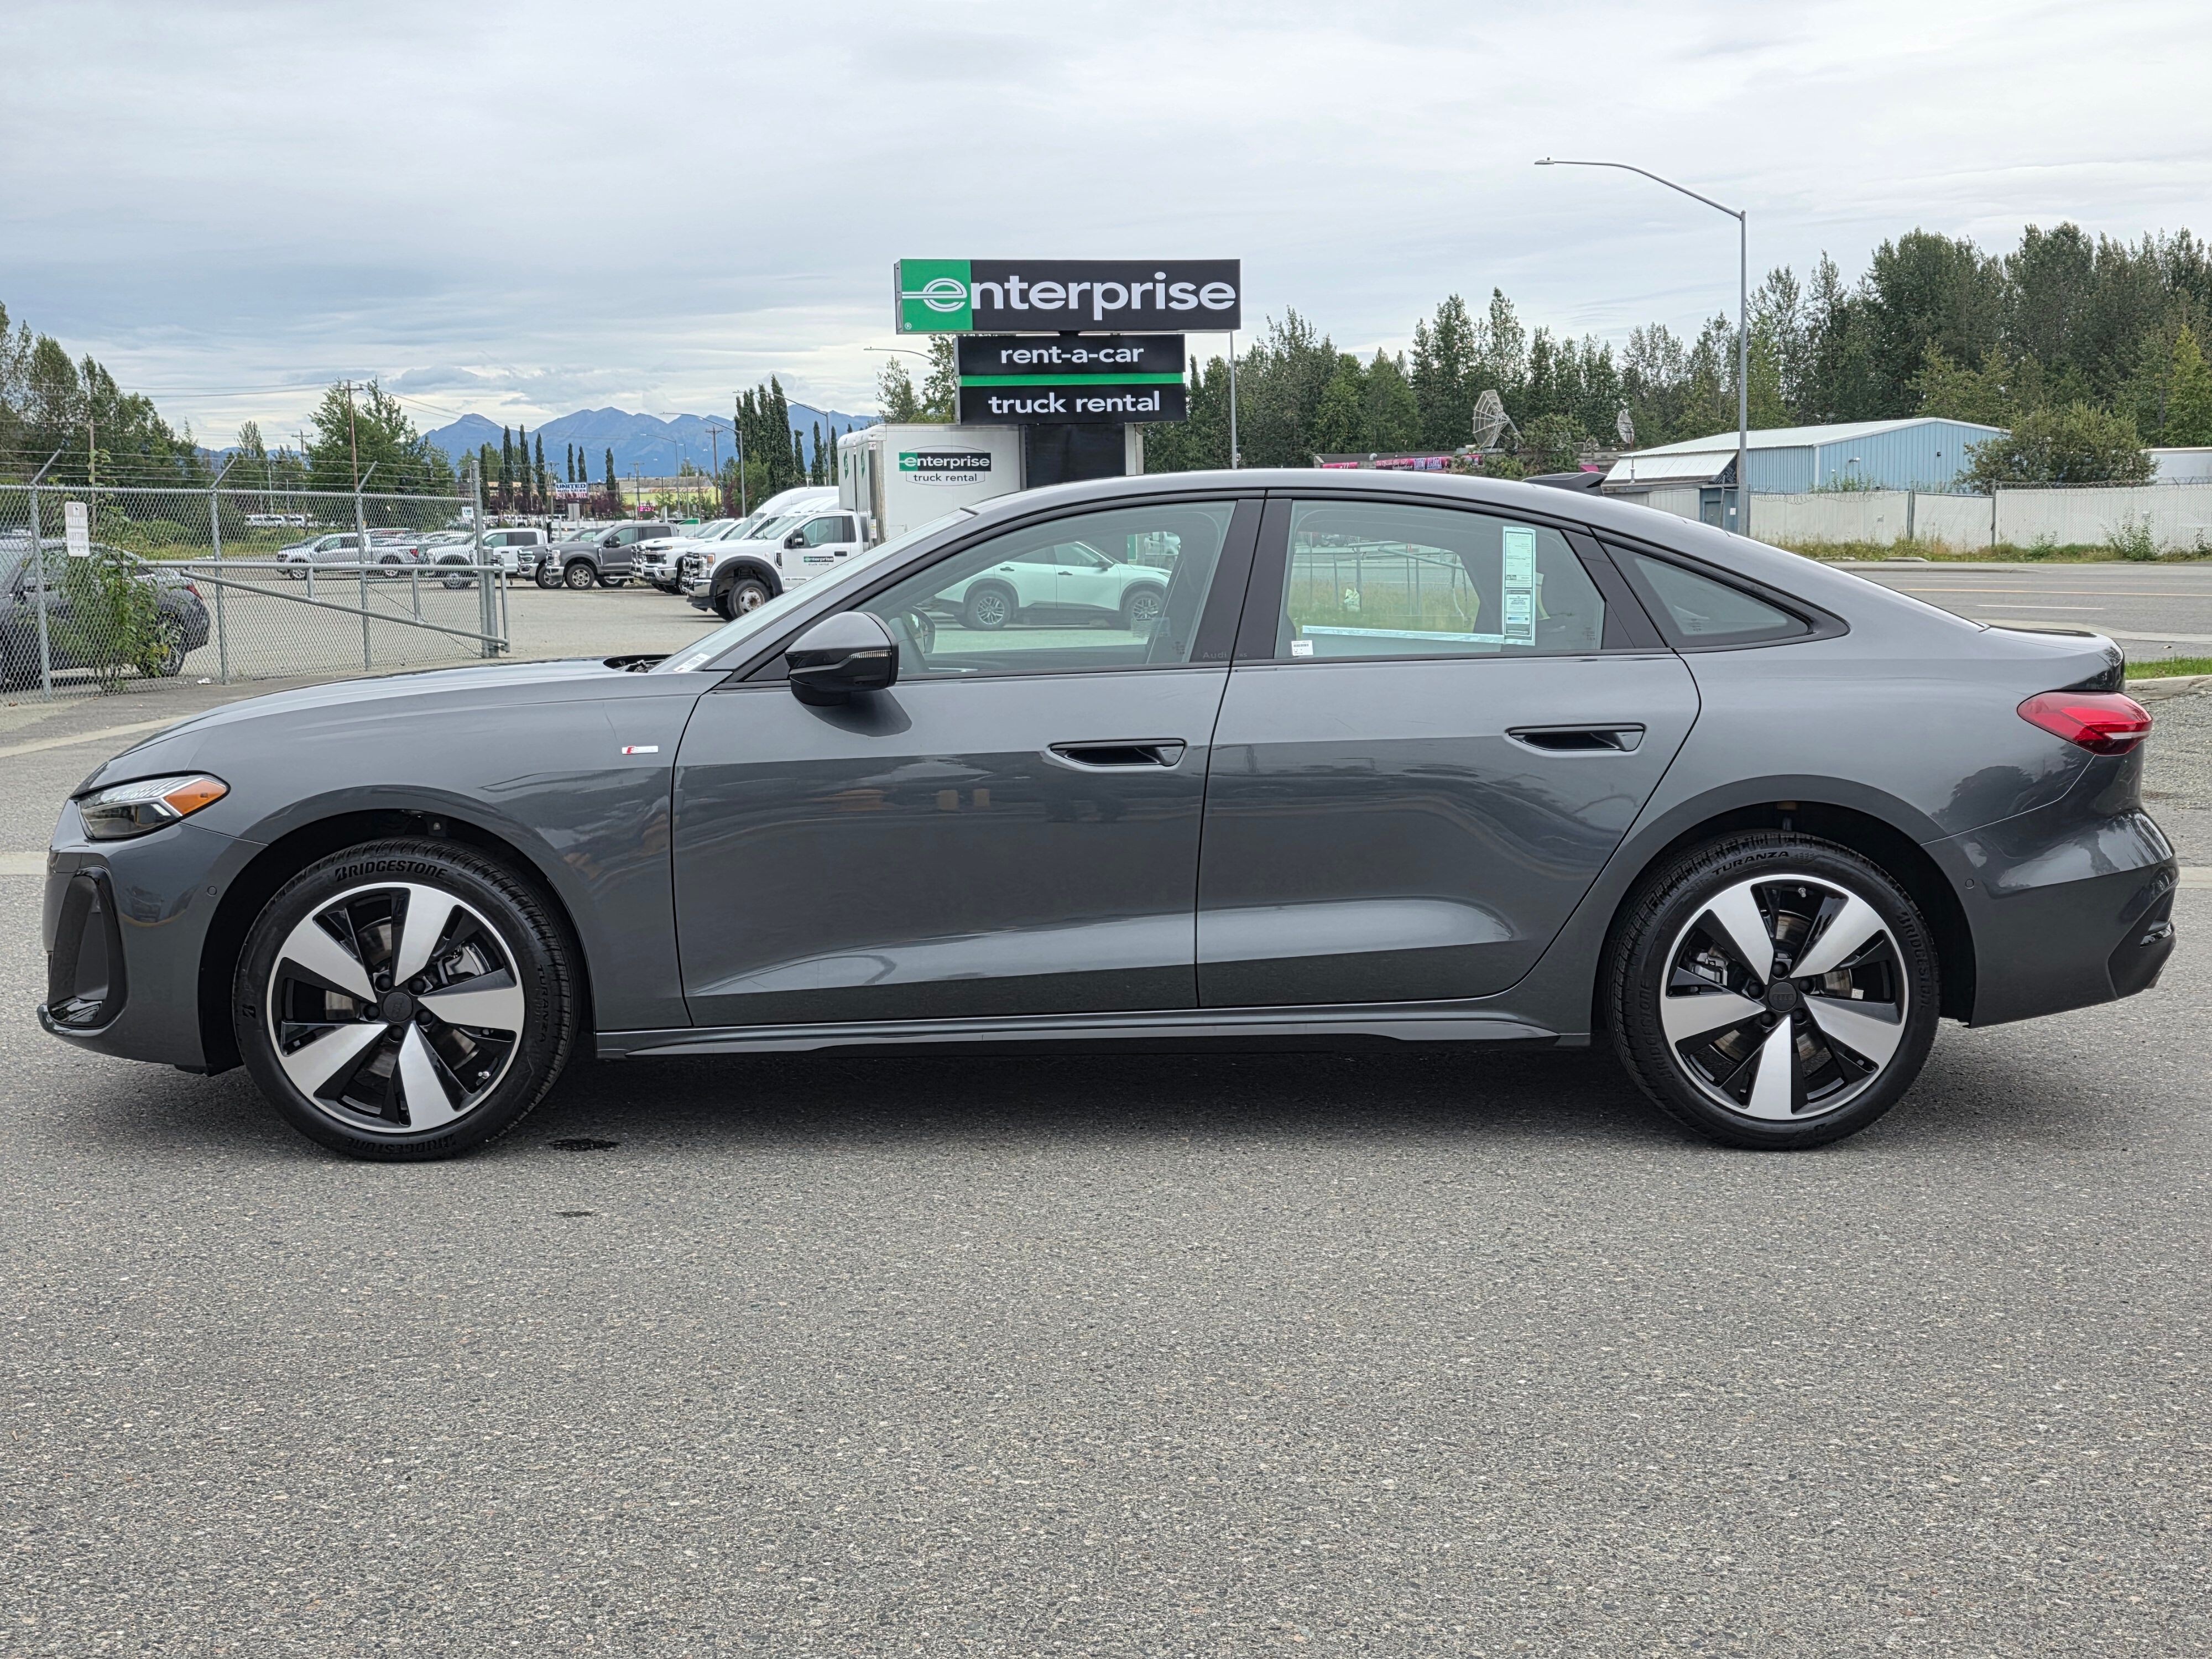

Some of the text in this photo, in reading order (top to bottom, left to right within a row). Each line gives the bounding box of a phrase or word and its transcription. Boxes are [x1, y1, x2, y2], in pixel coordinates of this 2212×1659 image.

[902, 272, 1237, 321] enterprise
[1000, 345, 1144, 364] rent-a-car
[988, 390, 1160, 414] truck rental
[899, 455, 990, 469] enterprise
[913, 473, 977, 482] truck rental
[335, 860, 448, 882] BRIDGESTONE
[1712, 851, 1789, 876] TURANZA
[537, 964, 549, 1043] TURANZA
